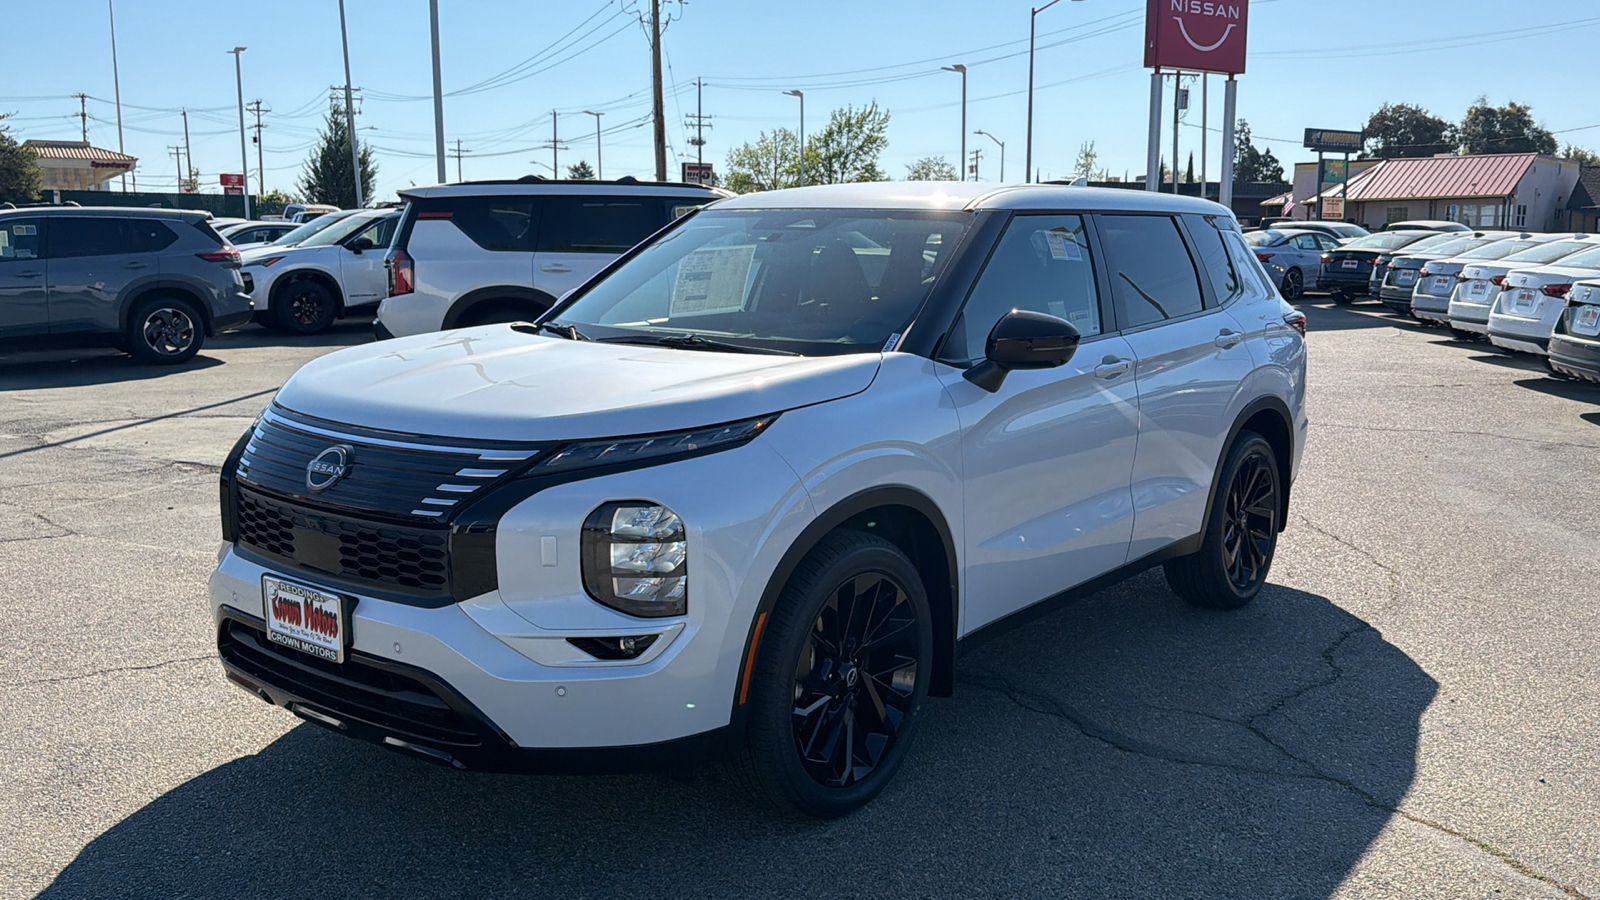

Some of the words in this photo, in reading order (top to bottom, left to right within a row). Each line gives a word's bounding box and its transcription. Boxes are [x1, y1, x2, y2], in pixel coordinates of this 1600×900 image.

[1171, 0, 1239, 19] NISSAN
[309, 462, 345, 475] SSAN
[280, 583, 319, 600] REDDING
[271, 595, 302, 627] Crown
[303, 598, 338, 639] Motors
[271, 632, 300, 648] CROWN
[302, 642, 336, 660] MOTORS
